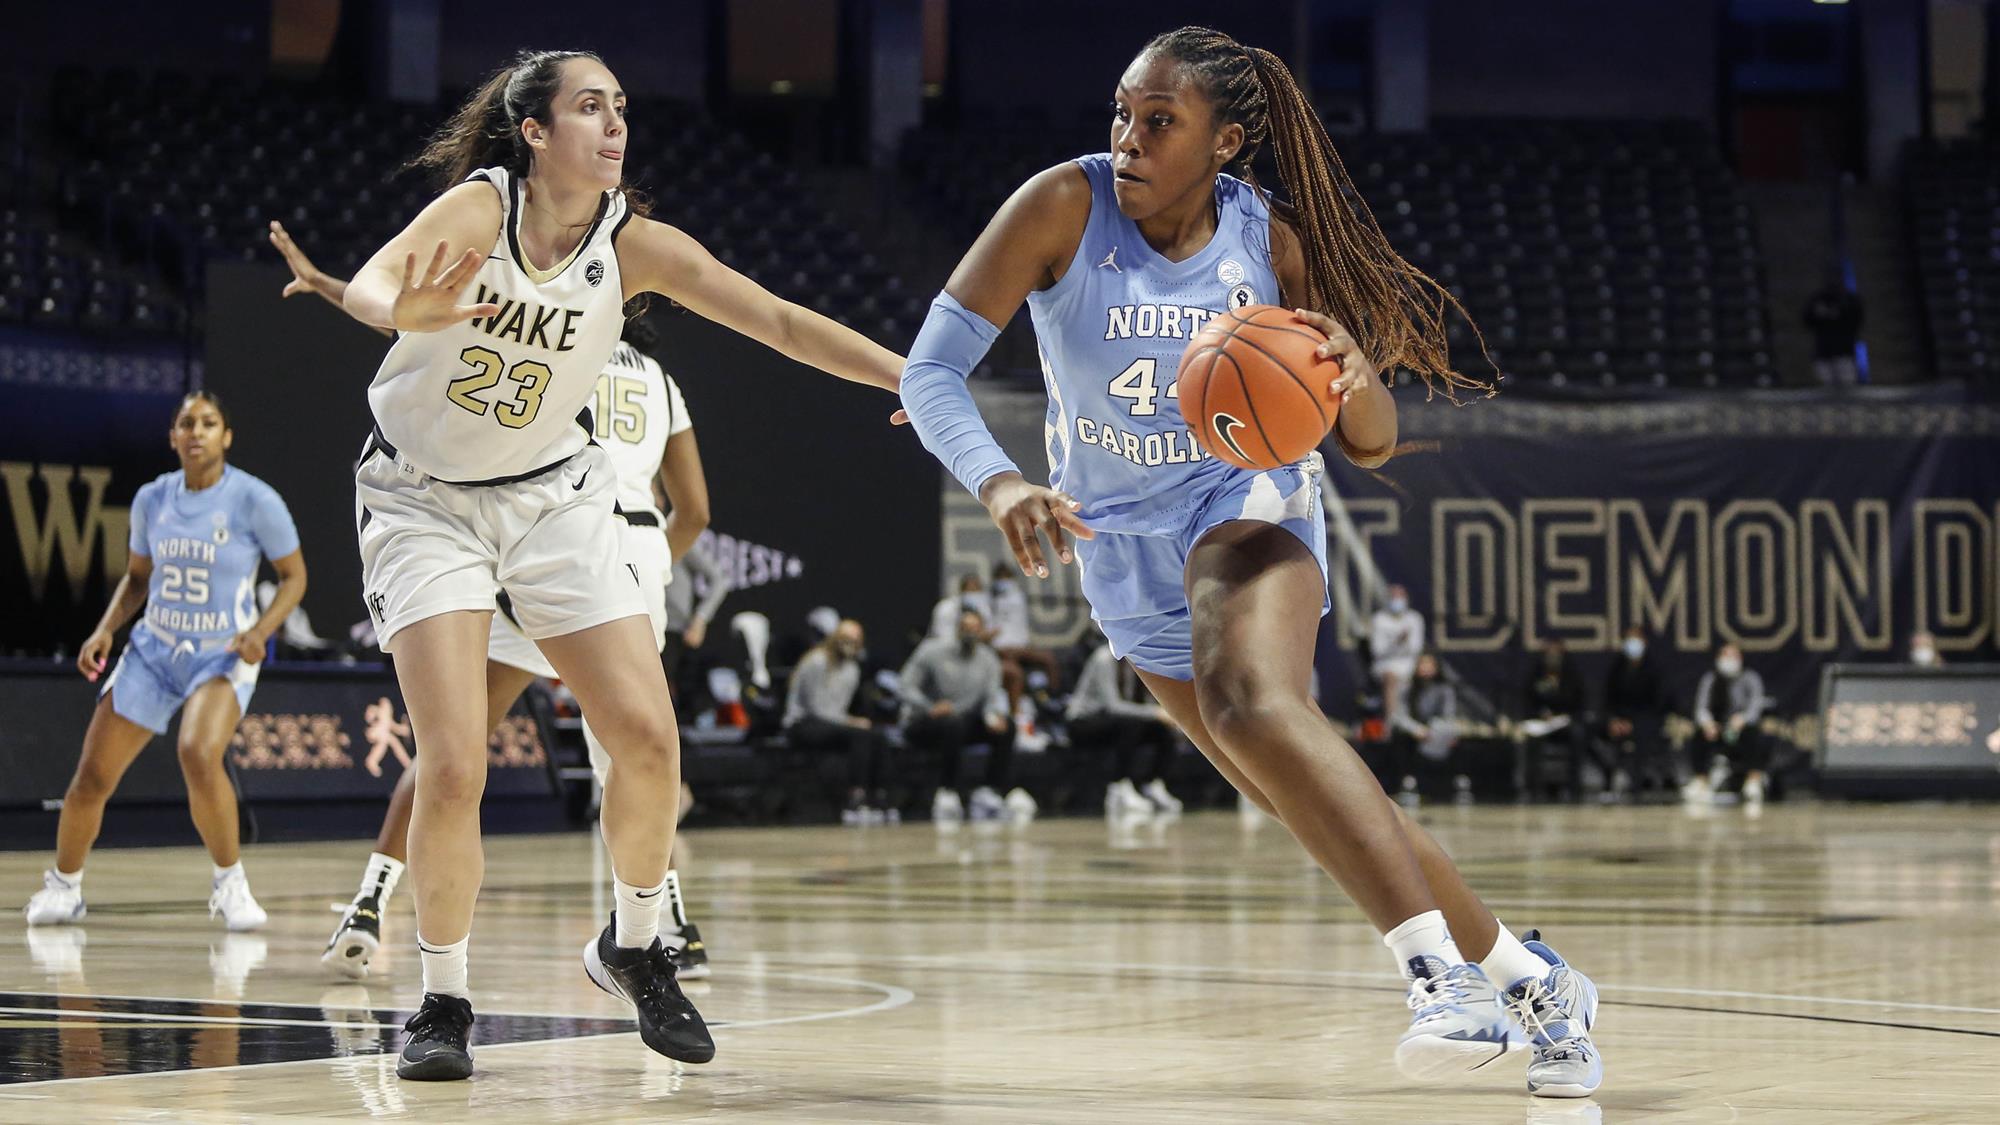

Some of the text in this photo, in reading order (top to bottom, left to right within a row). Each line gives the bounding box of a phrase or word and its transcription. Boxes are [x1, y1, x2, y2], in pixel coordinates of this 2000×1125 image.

[470, 284, 585, 352] WAKE
[446, 345, 552, 429] 23
[597, 373, 648, 445] 15
[1108, 357, 1180, 417] 4
[404, 463, 415, 474] 23
[1075, 416, 1212, 467] CAROLI
[157, 538, 216, 565] NORTH
[1431, 498, 1893, 652] DEMON
[1913, 498, 2000, 652] D
[160, 564, 210, 605] 25
